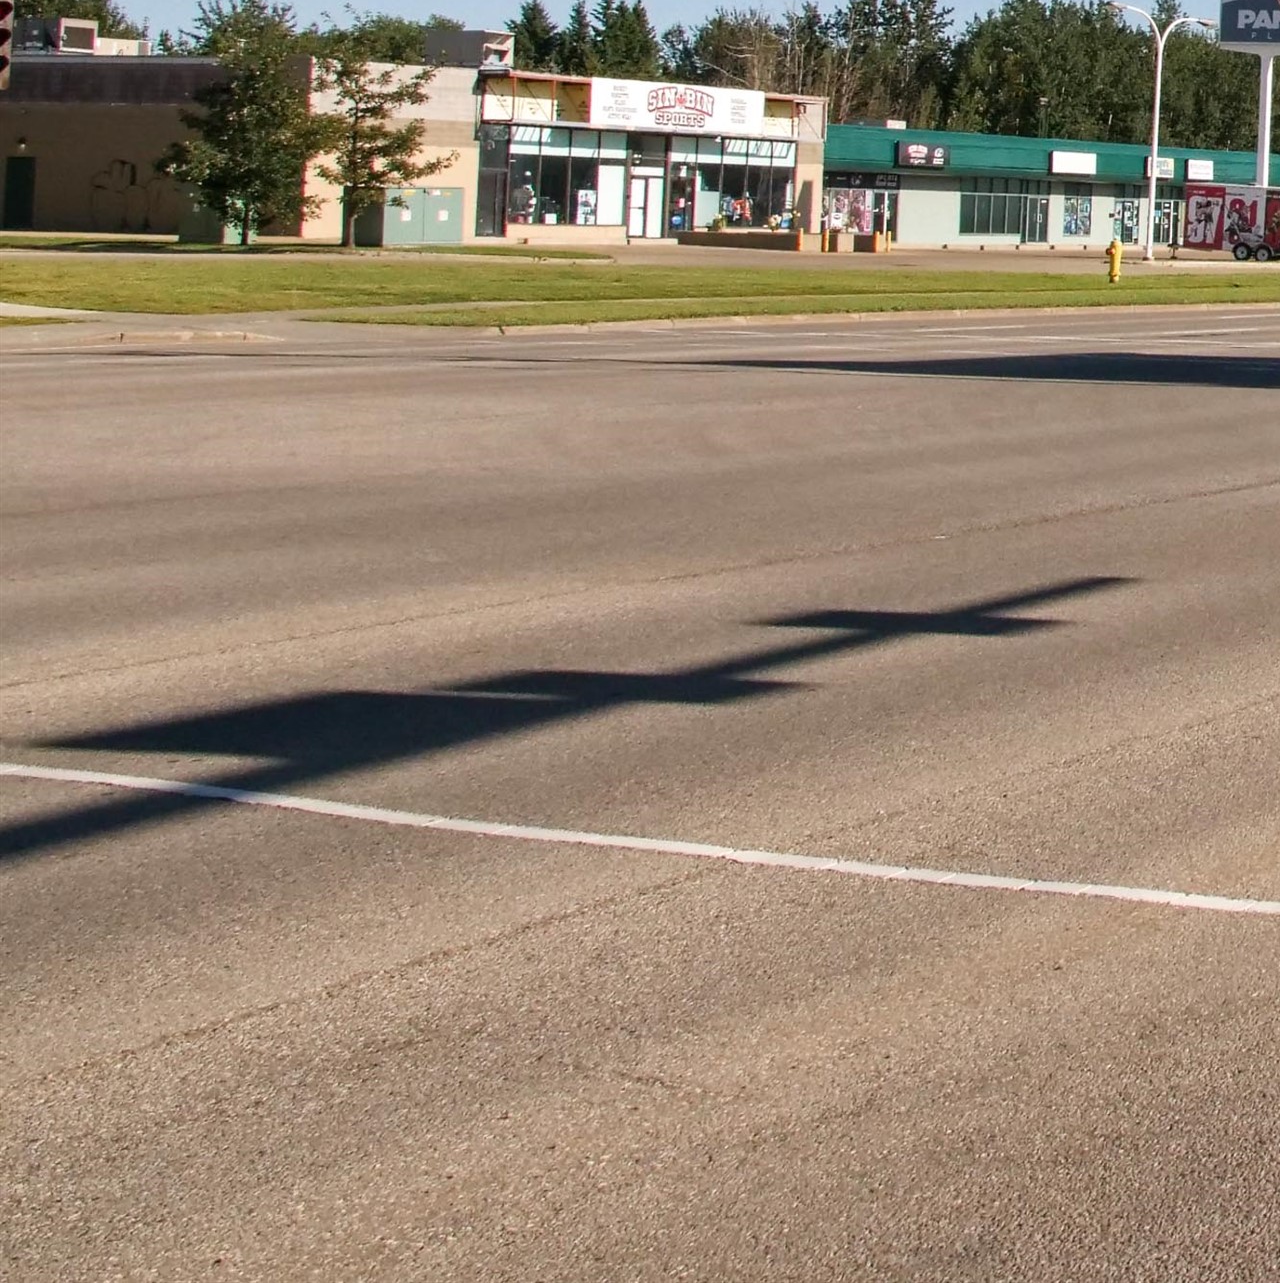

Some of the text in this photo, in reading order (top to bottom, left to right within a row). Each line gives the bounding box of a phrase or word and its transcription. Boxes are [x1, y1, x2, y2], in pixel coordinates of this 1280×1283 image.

[647, 86, 678, 112] SIN
[684, 87, 715, 117] BIN
[654, 111, 706, 128] SPORTS
